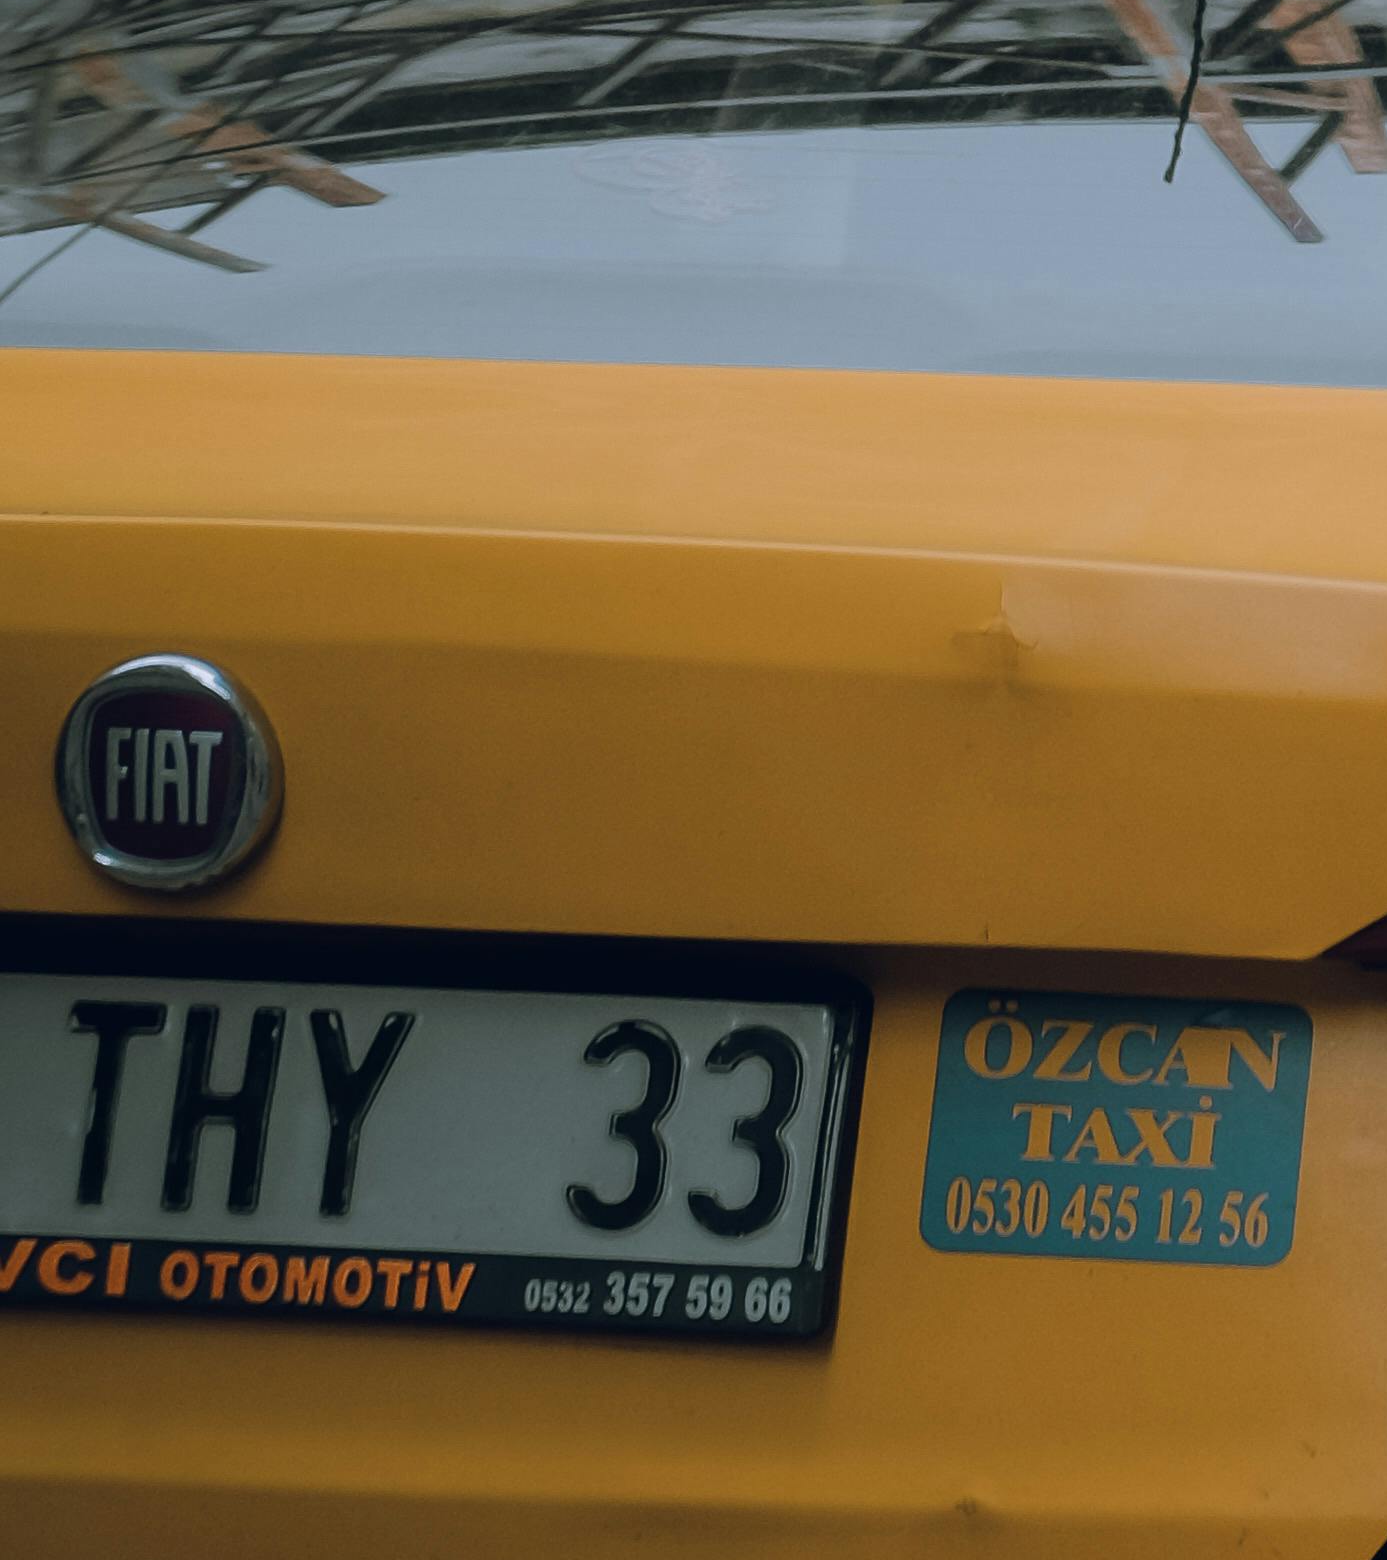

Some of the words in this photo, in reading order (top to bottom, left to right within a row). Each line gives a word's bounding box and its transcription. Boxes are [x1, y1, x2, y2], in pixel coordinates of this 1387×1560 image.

[104, 726, 224, 827] FIAT
[963, 998, 1288, 1093] ÖZCAN
[68, 998, 417, 1218] THY
[566, 1018, 804, 1238] 33
[945, 1175, 1051, 1239] 0530
[1060, 1183, 1141, 1243] 455
[1154, 1187, 1204, 1246] 12
[1217, 1190, 1271, 1249] 56
[523, 1279, 592, 1314] 0532
[602, 1271, 671, 1319] 357
[684, 1276, 735, 1322] 59
[743, 1278, 794, 1325] 66
